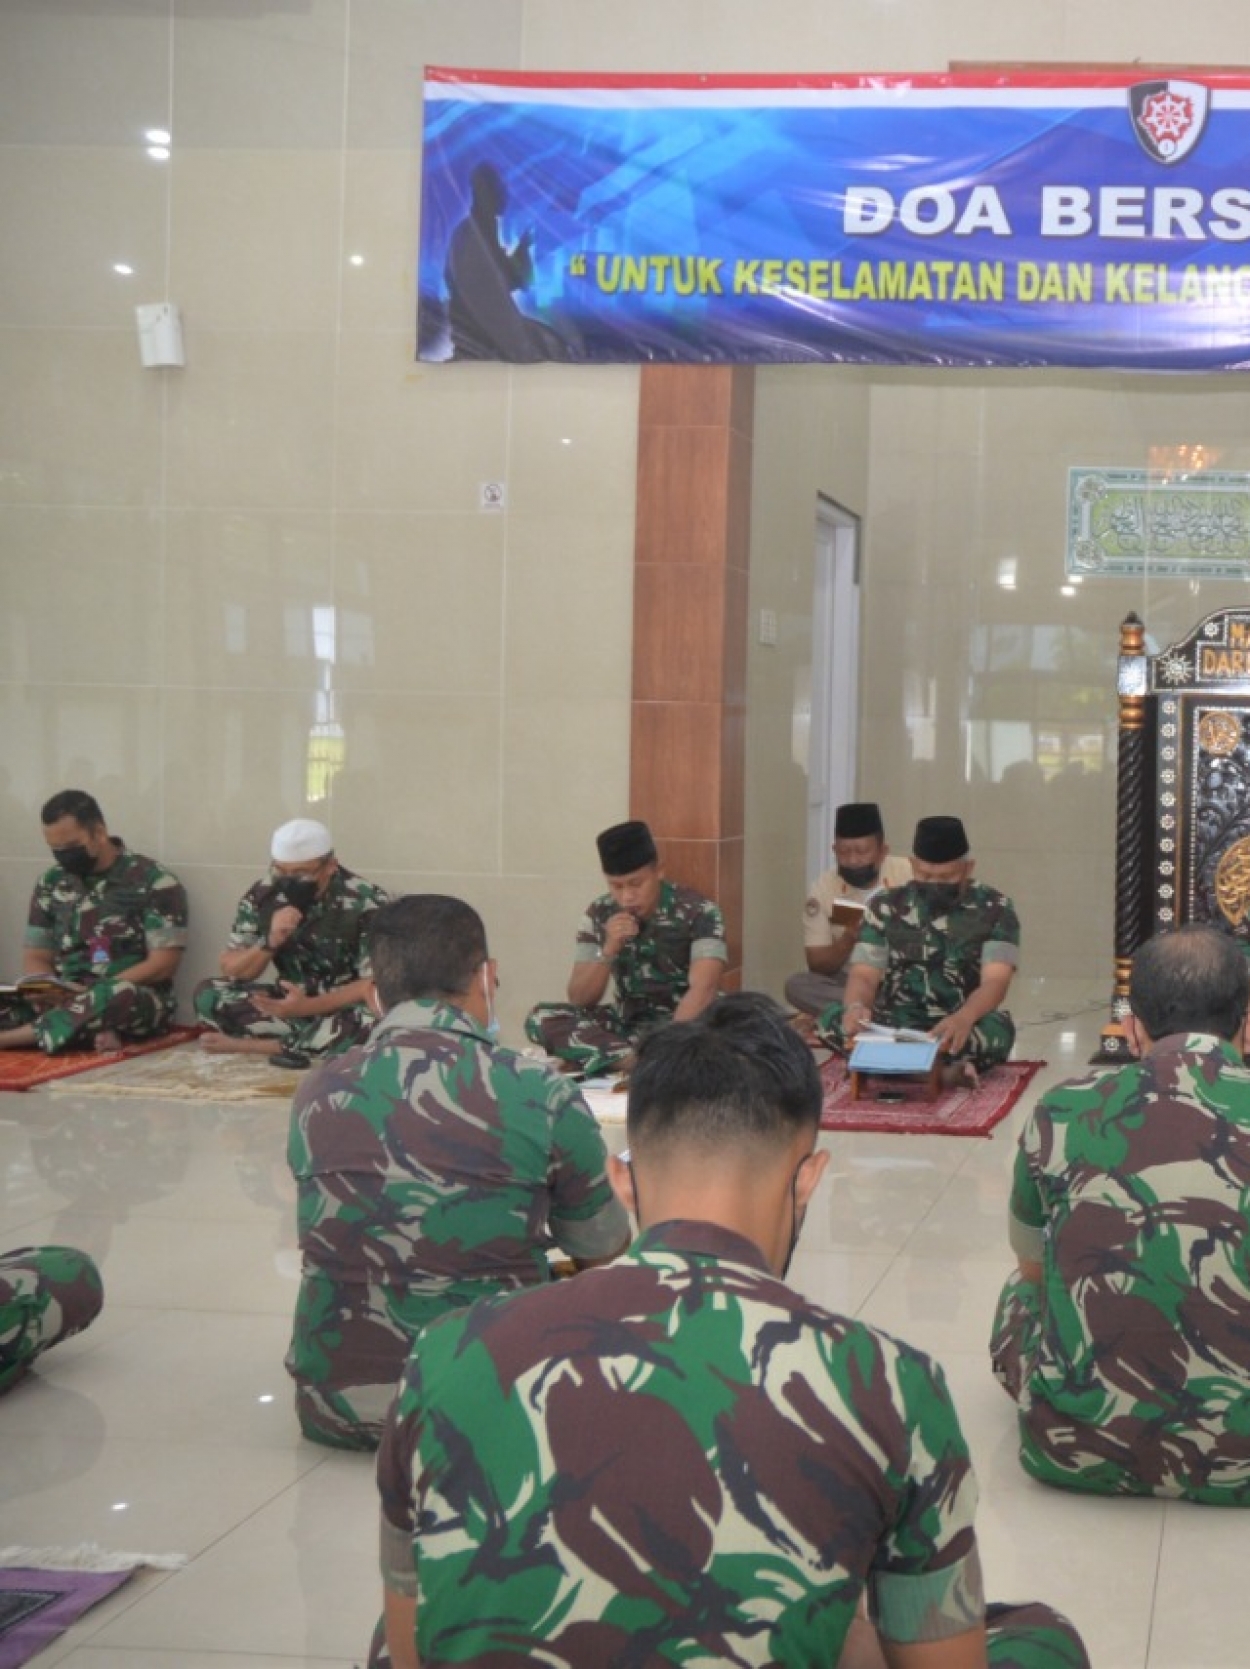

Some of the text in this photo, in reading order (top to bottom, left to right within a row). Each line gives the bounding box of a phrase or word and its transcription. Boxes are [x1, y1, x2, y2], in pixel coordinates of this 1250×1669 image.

[843, 184, 1013, 236] DOA
[596, 254, 723, 295] UNTUK
[733, 259, 1005, 301] KESELAMATAN
[1017, 262, 1093, 302] DAN
